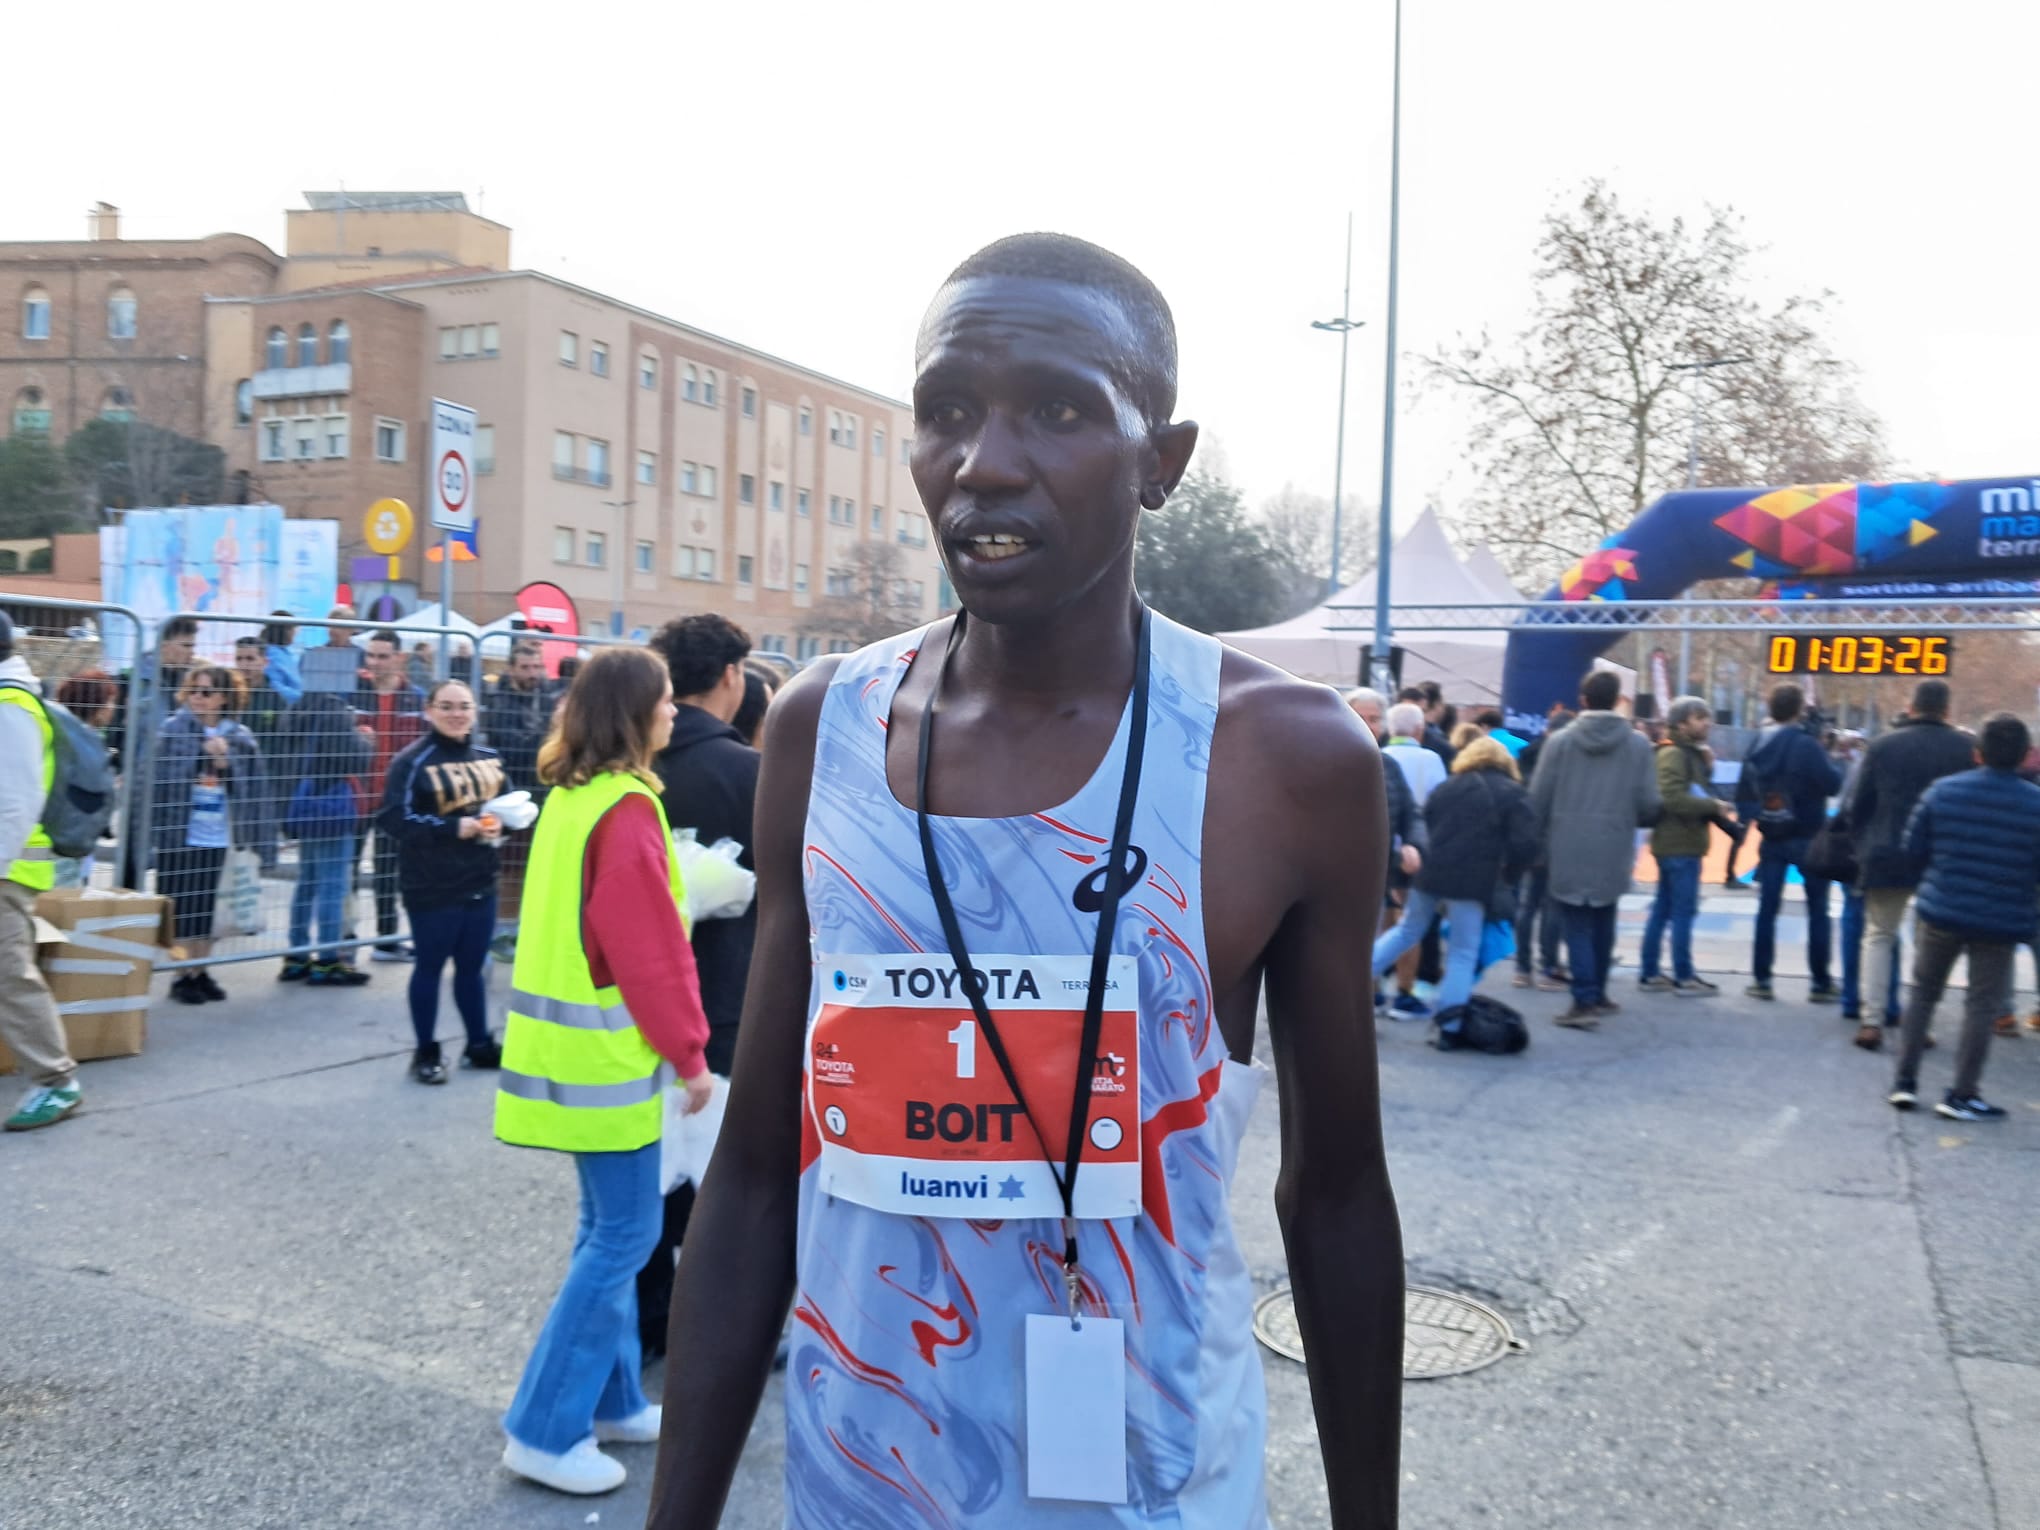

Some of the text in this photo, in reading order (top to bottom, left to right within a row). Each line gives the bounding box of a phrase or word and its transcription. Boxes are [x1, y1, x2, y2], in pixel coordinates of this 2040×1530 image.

[445, 471, 461, 491] 30
[885, 967, 1041, 1000] TOYOTA
[1061, 979, 1119, 991] TERRSA
[947, 1020, 976, 1078] 1
[905, 1101, 1026, 1143] BOIT
[902, 1171, 988, 1198] luanvi
